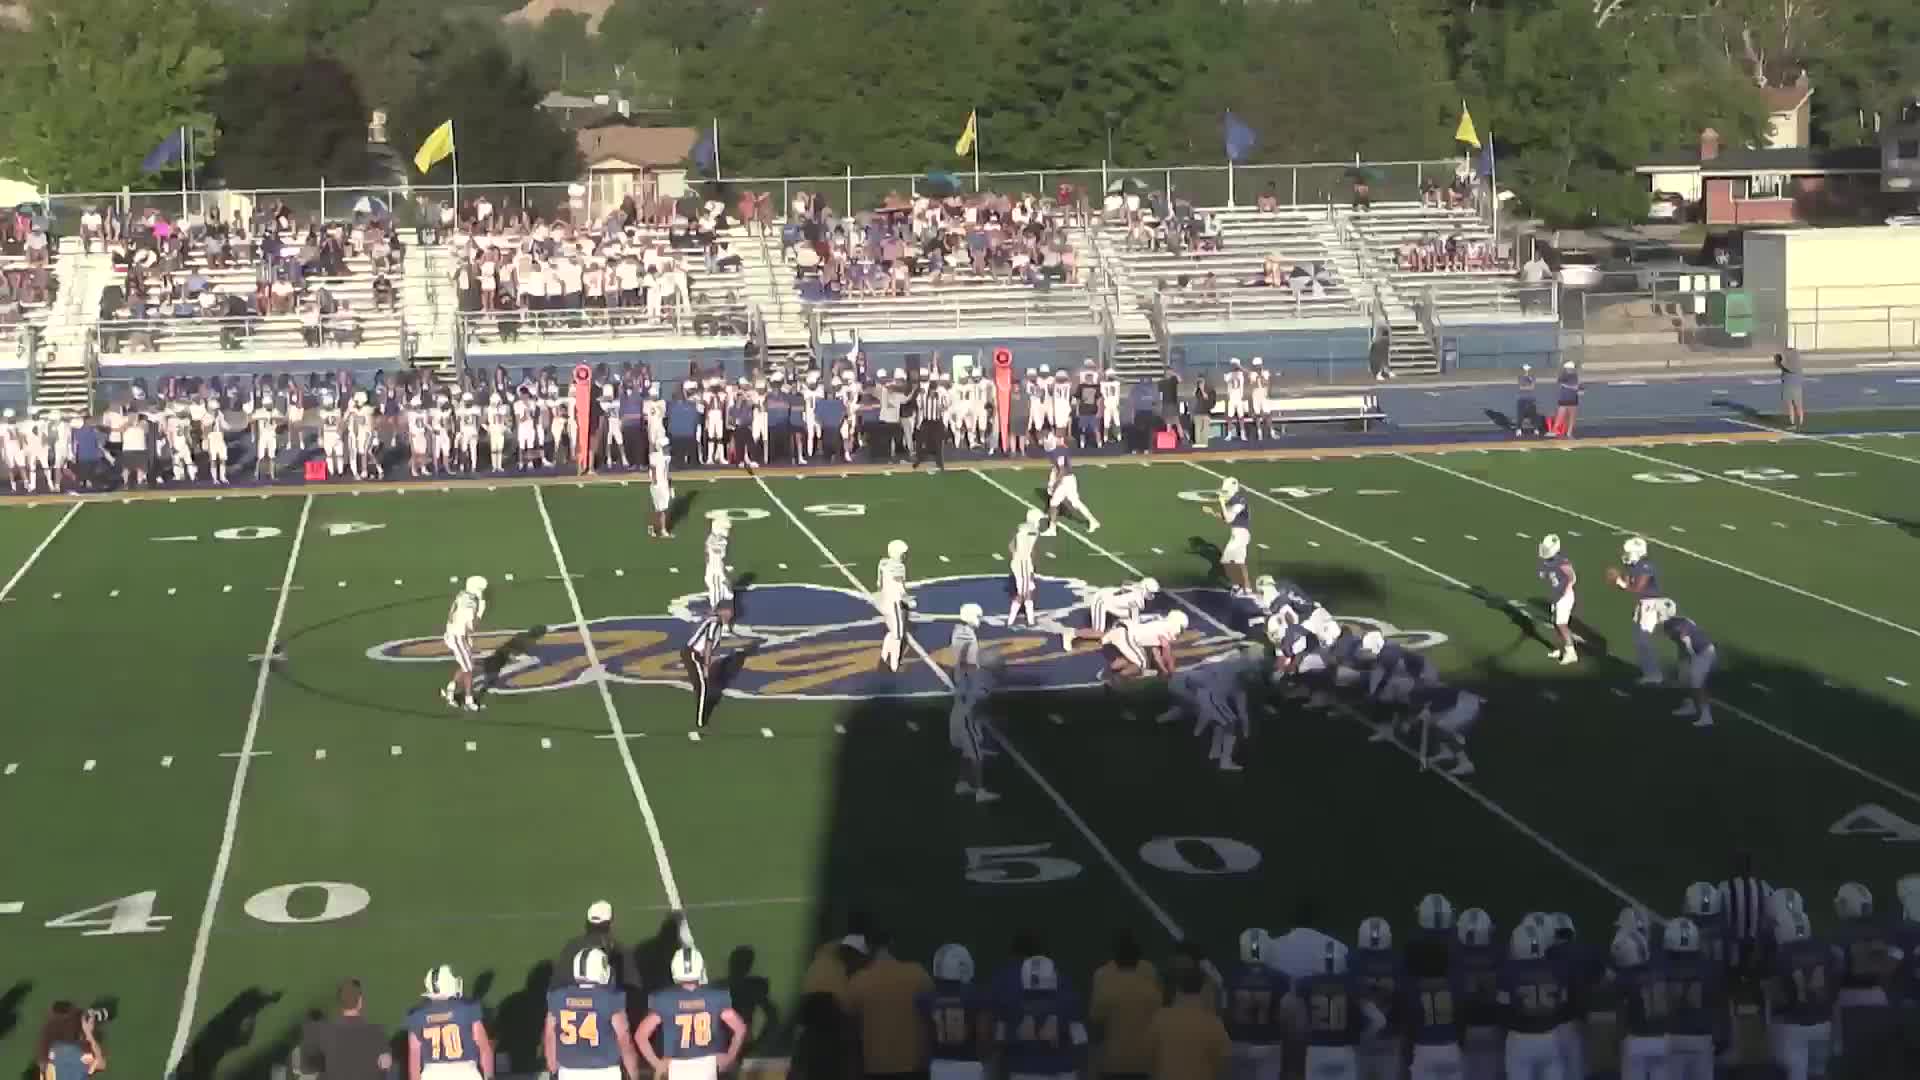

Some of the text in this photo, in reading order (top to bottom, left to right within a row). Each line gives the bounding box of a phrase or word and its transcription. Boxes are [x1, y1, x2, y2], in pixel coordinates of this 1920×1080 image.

[423, 1024, 463, 1060] 70
[560, 1009, 599, 1048] 54
[675, 1011, 712, 1049] 78
